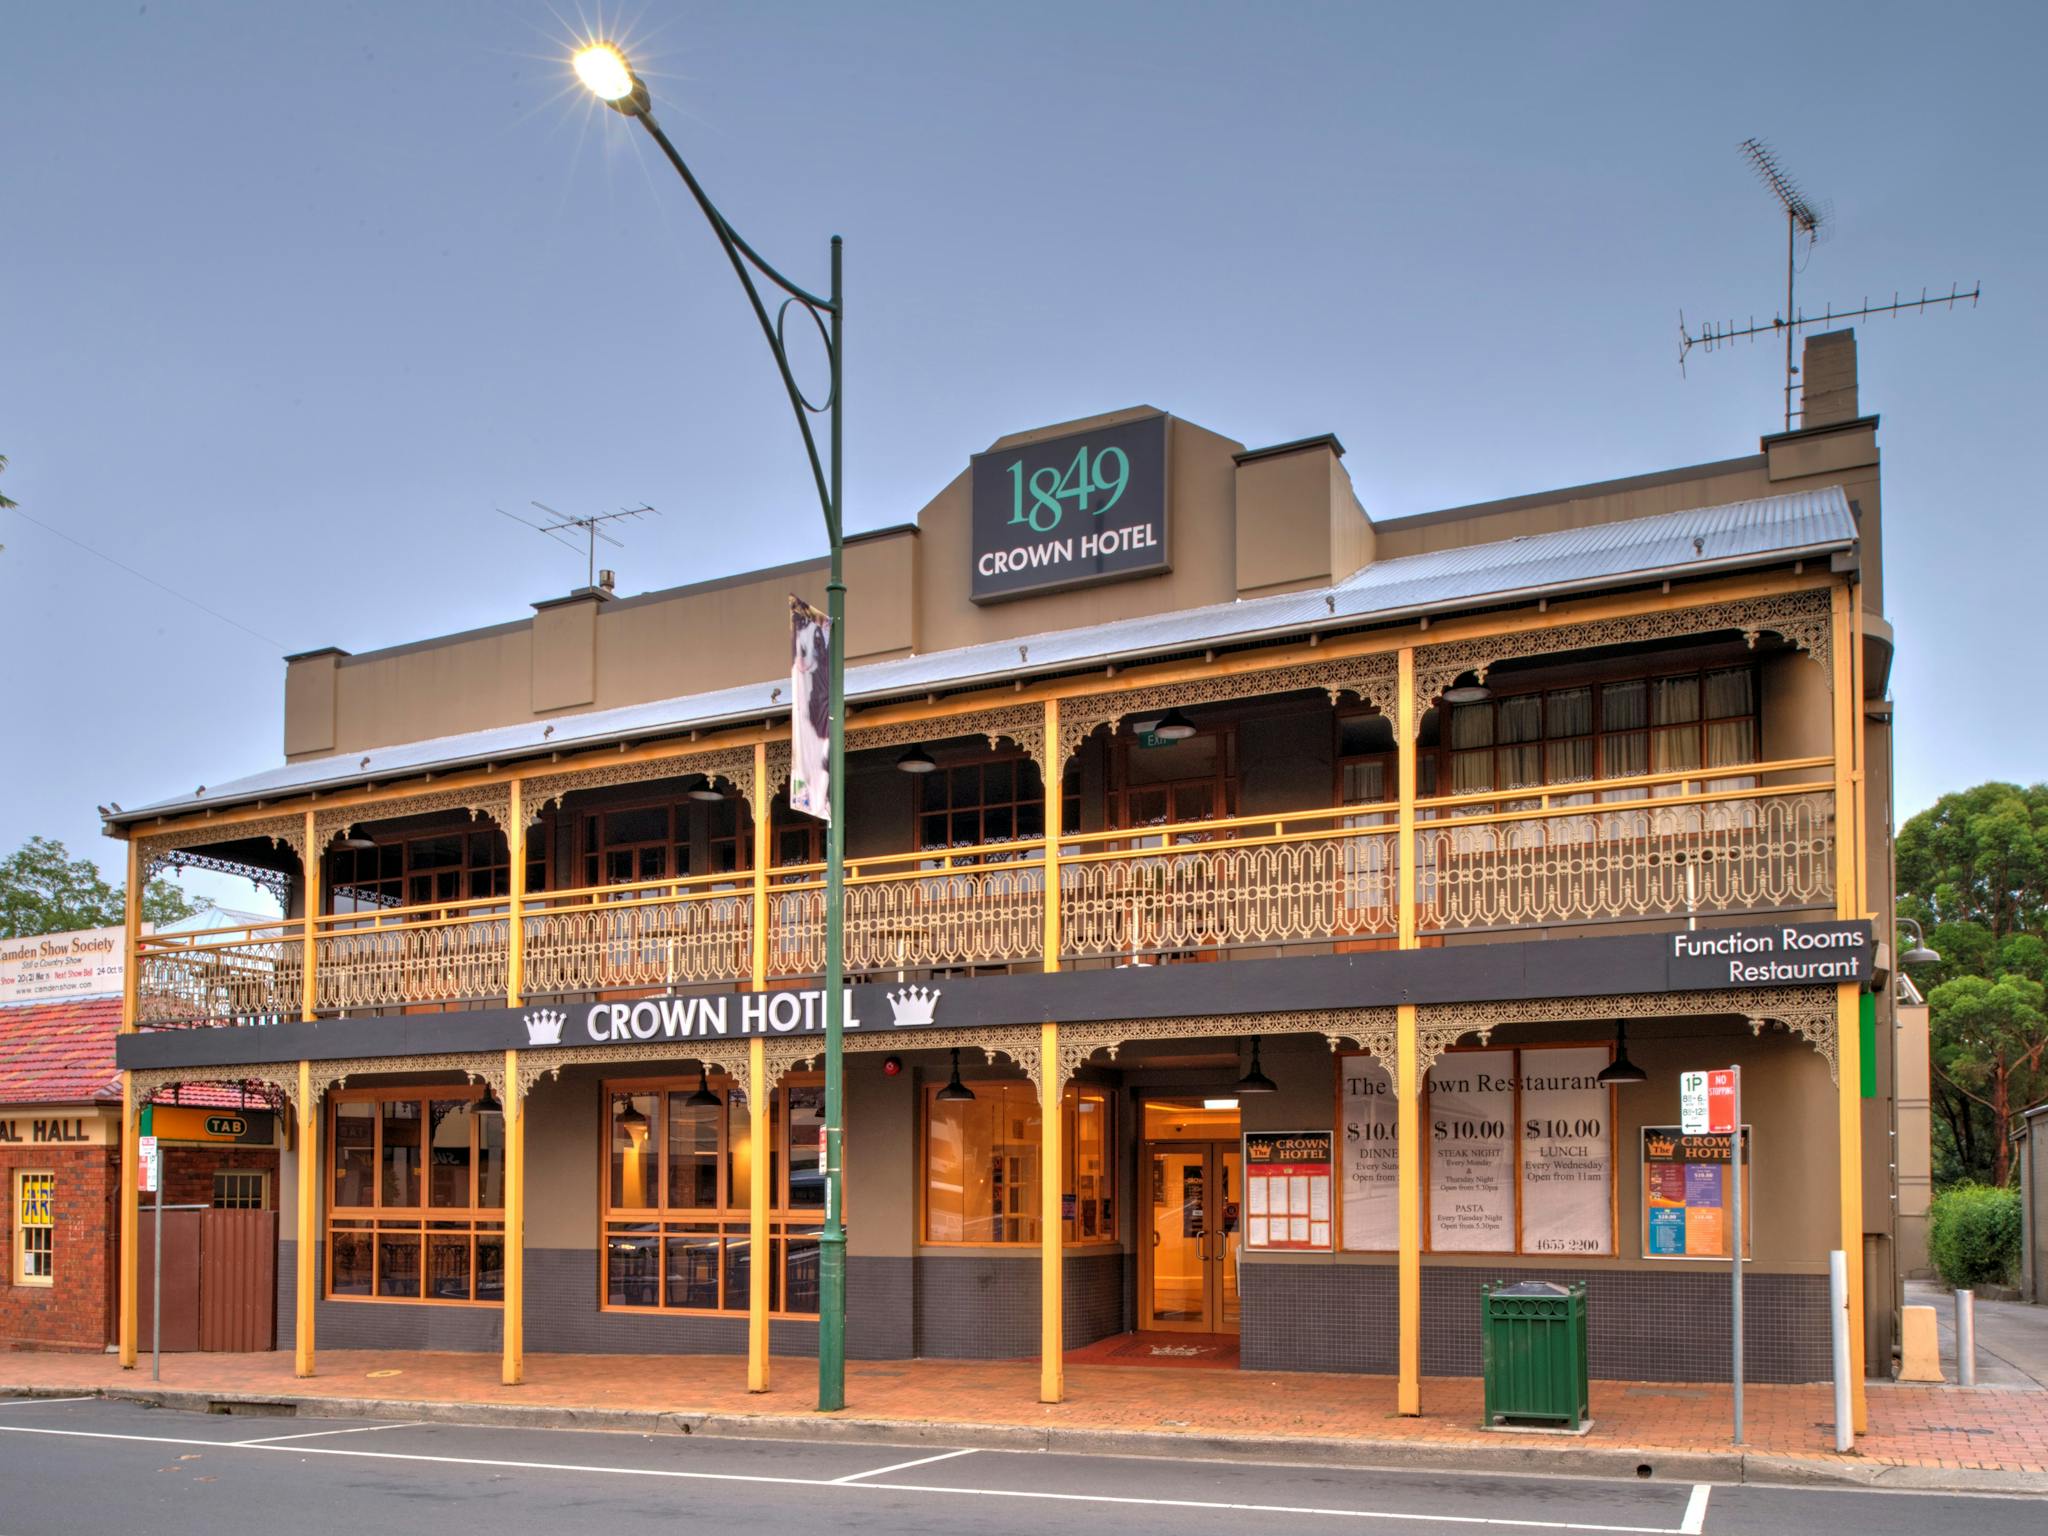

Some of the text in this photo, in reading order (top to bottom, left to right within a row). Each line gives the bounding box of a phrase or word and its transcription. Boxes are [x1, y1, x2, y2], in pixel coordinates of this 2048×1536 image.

[1007, 446, 1130, 532] 1849
[978, 523, 1157, 576] CROWN HOTEL
[1674, 928, 1864, 957] Function Rooms
[0, 937, 115, 961] amden Show Society
[39, 957, 65, 968] Country
[65, 956, 82, 965] Show
[1729, 957, 1859, 982] Restaurant
[587, 997, 728, 1042] CROWN
[1686, 1077, 1703, 1091] 1P
[1715, 1075, 1727, 1085] NO
[1347, 1077, 1386, 1096] The
[1428, 1078, 1470, 1095] own
[33, 1119, 90, 1142] HALL
[211, 1119, 242, 1132] TAB
[1434, 1120, 1505, 1142] $10.00
[1526, 1119, 1601, 1140] $10.00
[1347, 1121, 1400, 1143] $10.0
[1275, 1139, 1330, 1149] CROWN
[1280, 1149, 1327, 1159] HOTEL
[1359, 1149, 1400, 1159] DINNE
[1438, 1148, 1502, 1158] STEAK NIGHT
[1539, 1146, 1588, 1158] LUNCH
[1653, 1146, 1670, 1154] The
[1685, 1147, 1732, 1158] HOTE
[1356, 1162, 1380, 1172] Every
[1446, 1158, 1492, 1167] Every Monday
[1525, 1160, 1603, 1171] Every Wednesday
[1352, 1172, 1396, 1183] Open from
[1446, 1175, 1494, 1184] Thursday Night
[1527, 1171, 1602, 1182] Open from 11am
[1440, 1184, 1458, 1192] Open
[1458, 1183, 1474, 1191] from
[1455, 1204, 1485, 1212] PASTA
[1437, 1214, 1503, 1223] Every Tuesday Night
[1440, 1222, 1458, 1231] Open
[1459, 1222, 1474, 1230] from
[1535, 1239, 1599, 1251] 4655 2200
